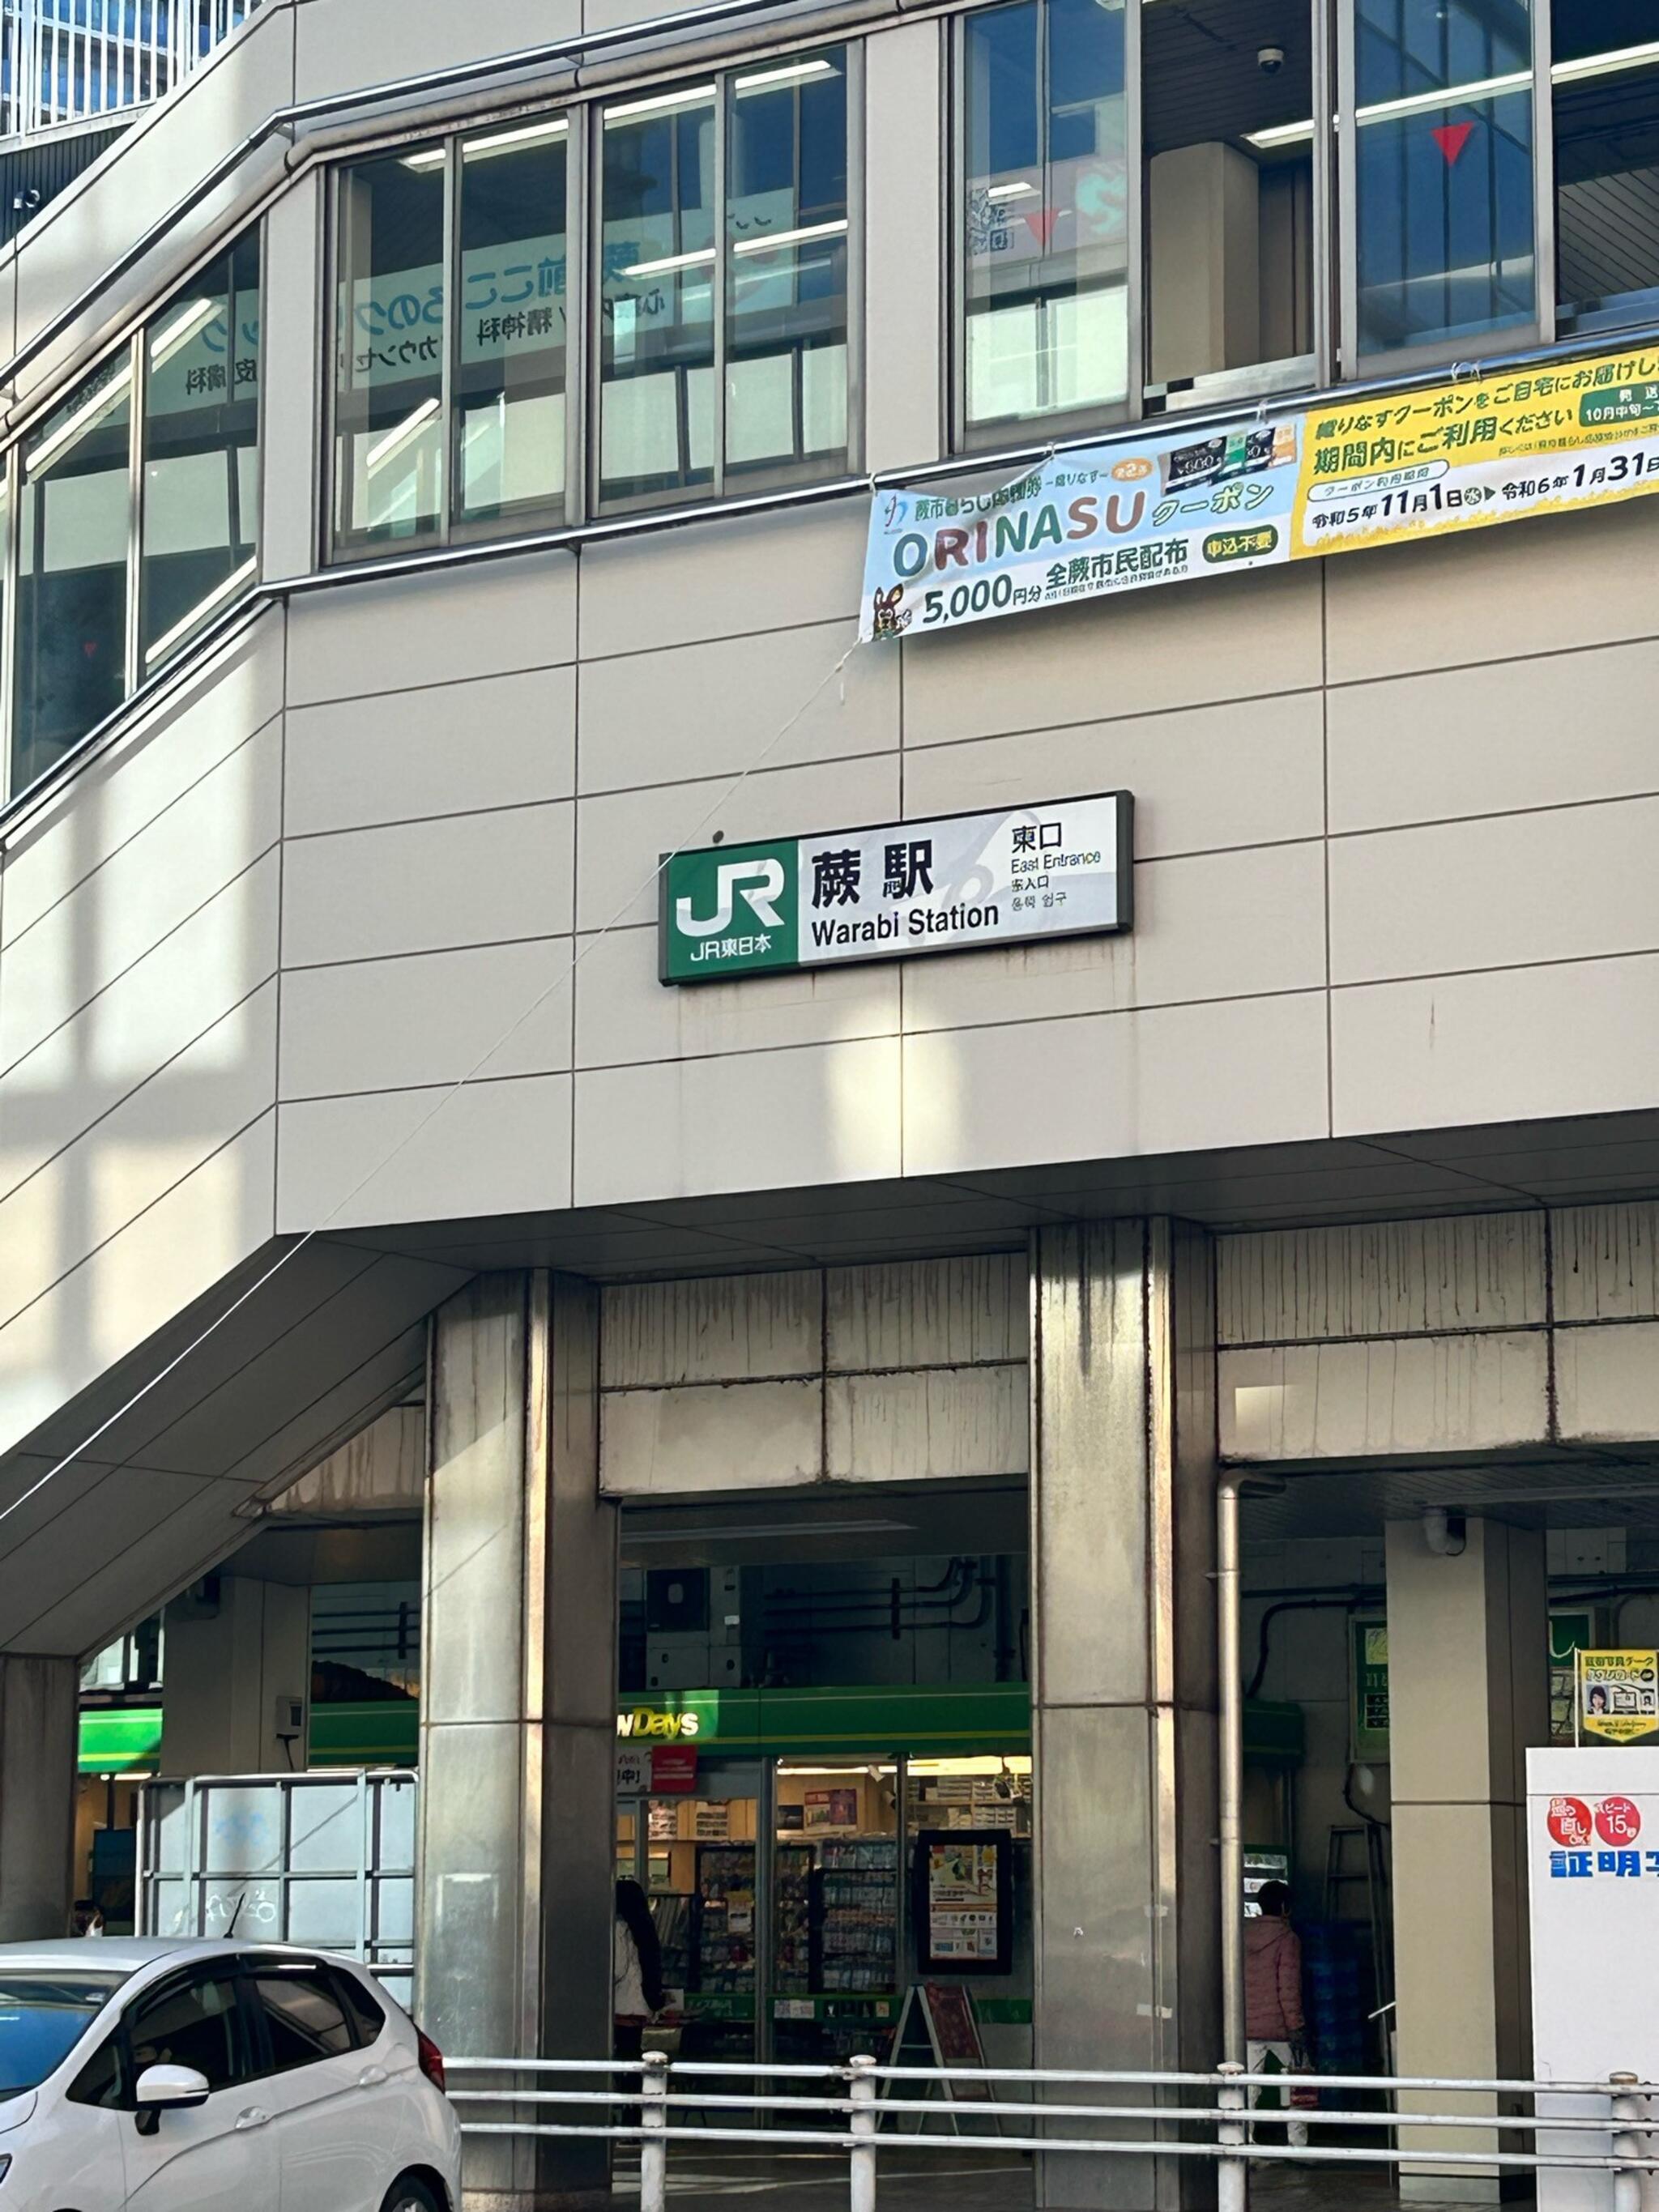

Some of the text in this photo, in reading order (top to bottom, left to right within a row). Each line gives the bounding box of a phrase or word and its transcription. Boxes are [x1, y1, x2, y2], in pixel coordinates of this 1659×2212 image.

[1316, 356, 1659, 440] 織りなすクーポンをご自宅にお届けし
[1313, 408, 1572, 475] 期間内にご利用ください
[1152, 482, 1274, 526] クーポン
[893, 491, 1145, 578] ORINASU
[1046, 538, 1189, 590] 全蕨市民配布
[1012, 822, 1061, 853] 東口
[1012, 851, 1101, 874] East Entrance
[676, 859, 785, 937] JR
[690, 933, 771, 961] JR東日本
[812, 902, 999, 947] Warabi Station
[616, 1707, 699, 1740] wDays
